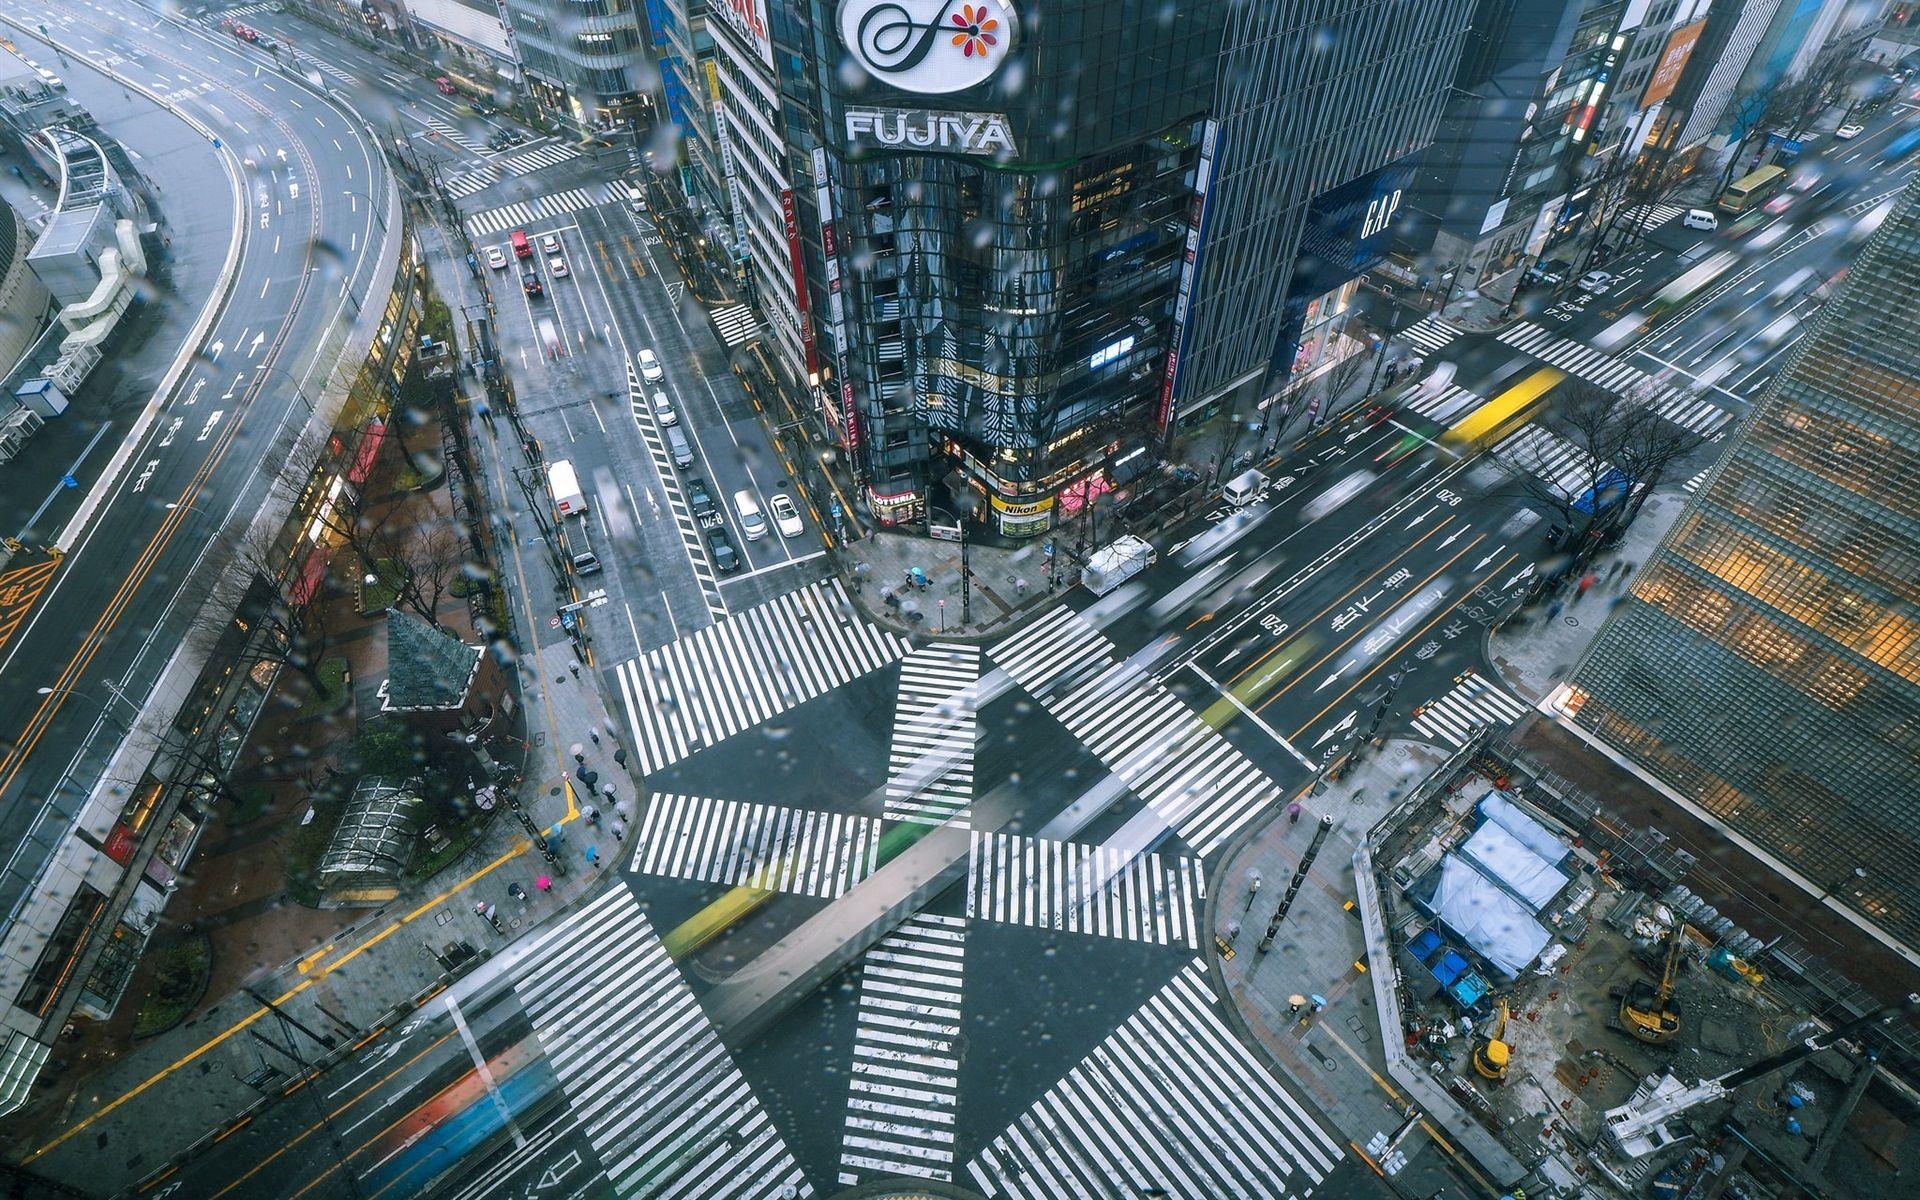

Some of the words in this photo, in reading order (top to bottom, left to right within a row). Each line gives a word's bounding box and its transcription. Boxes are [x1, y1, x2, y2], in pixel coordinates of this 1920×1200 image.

[845, 111, 1018, 157] FUJIYA
[1361, 189, 1402, 240] GAP
[1543, 307, 1573, 322] 17-19
[874, 493, 917, 505] LOTTERIA
[1436, 489, 1462, 506] 8-20
[1005, 505, 1038, 514] Nikon
[700, 512, 723, 529] 8-20
[1331, 567, 1413, 633] 地下道
[1260, 614, 1288, 636] 8-20
[1639, 1026, 1659, 1040] CAT
